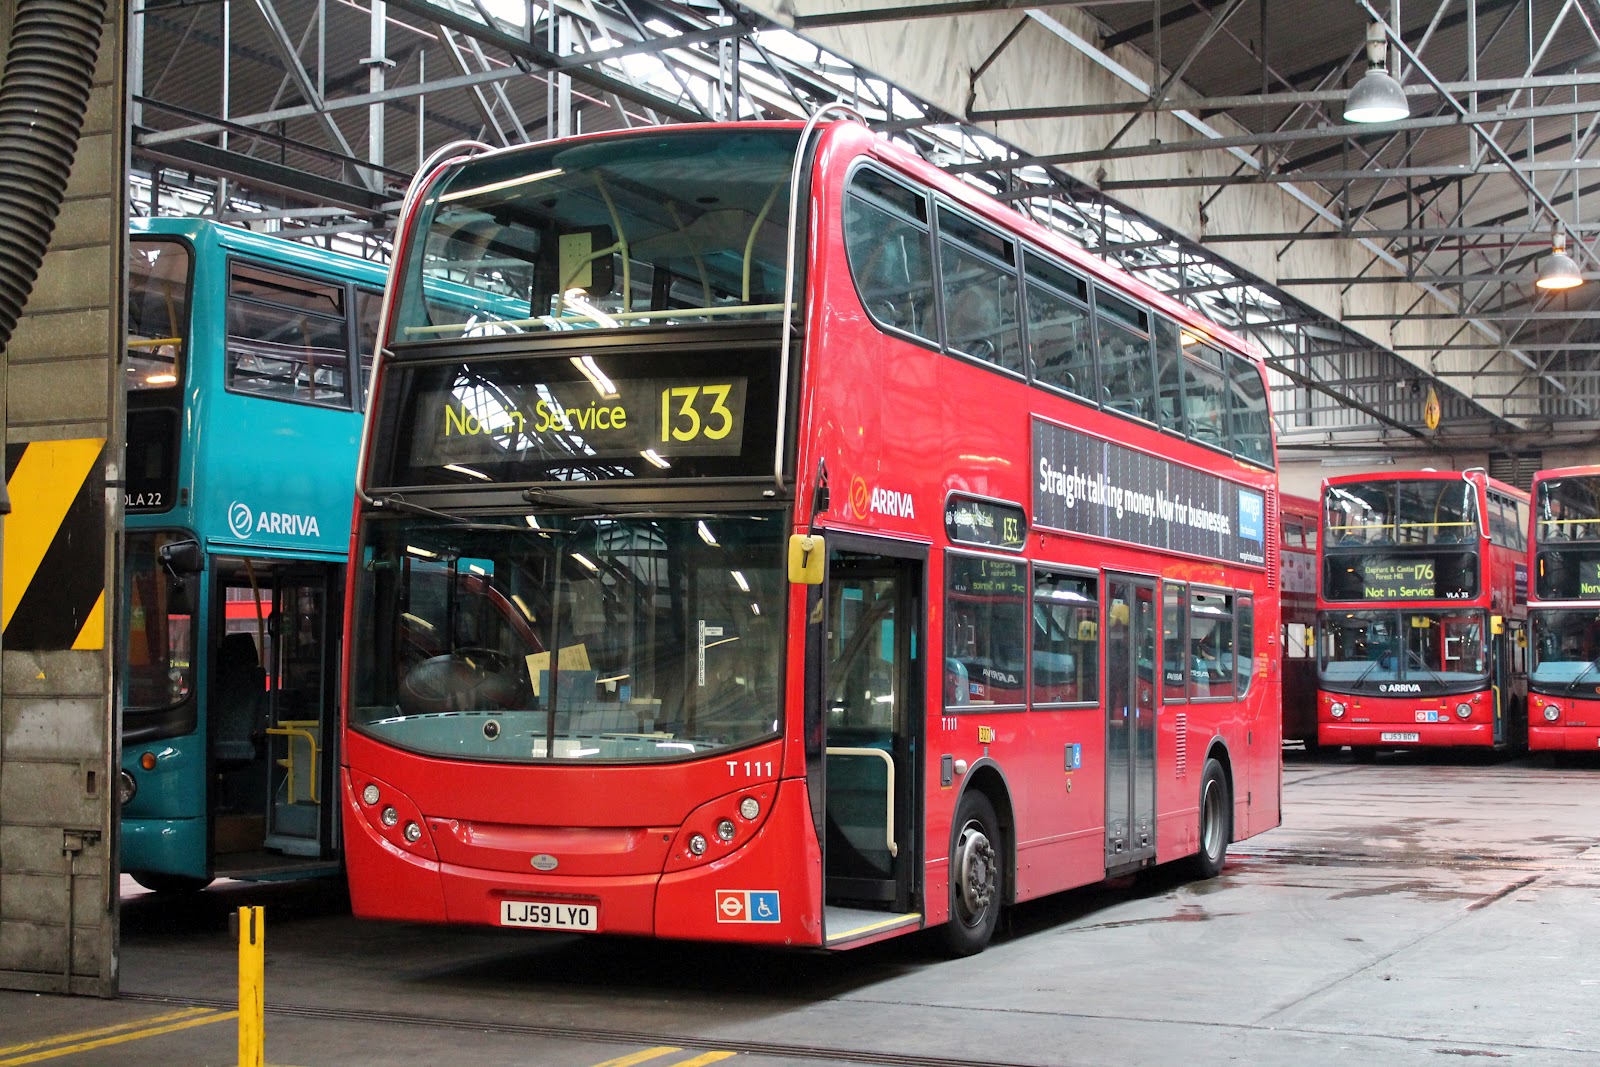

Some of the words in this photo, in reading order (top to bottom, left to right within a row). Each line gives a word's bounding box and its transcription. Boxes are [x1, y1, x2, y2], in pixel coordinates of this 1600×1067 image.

[534, 400, 627, 433] Service
[661, 384, 733, 442] 133
[147, 493, 162, 505] 22
[870, 487, 915, 519] ARRIVA
[1039, 457, 1086, 509] Straight
[1086, 472, 1124, 519] talking
[1124, 489, 1155, 526] money.
[1156, 489, 1174, 522] Now
[1175, 494, 1188, 525] for
[1188, 498, 1231, 536] businesses.
[256, 511, 321, 537] ARRIVA
[1003, 517, 1018, 542] 133
[1396, 565, 1414, 573] Castle
[1414, 564, 1435, 580] 176
[1365, 587, 1385, 598] Not
[1387, 587, 1397, 597] in
[1400, 586, 1435, 597] Service
[1388, 684, 1421, 692] ARRIVA
[726, 761, 738, 777] T
[744, 761, 772, 777] 111
[507, 904, 551, 923] LJ59
[556, 906, 589, 926] LYO
